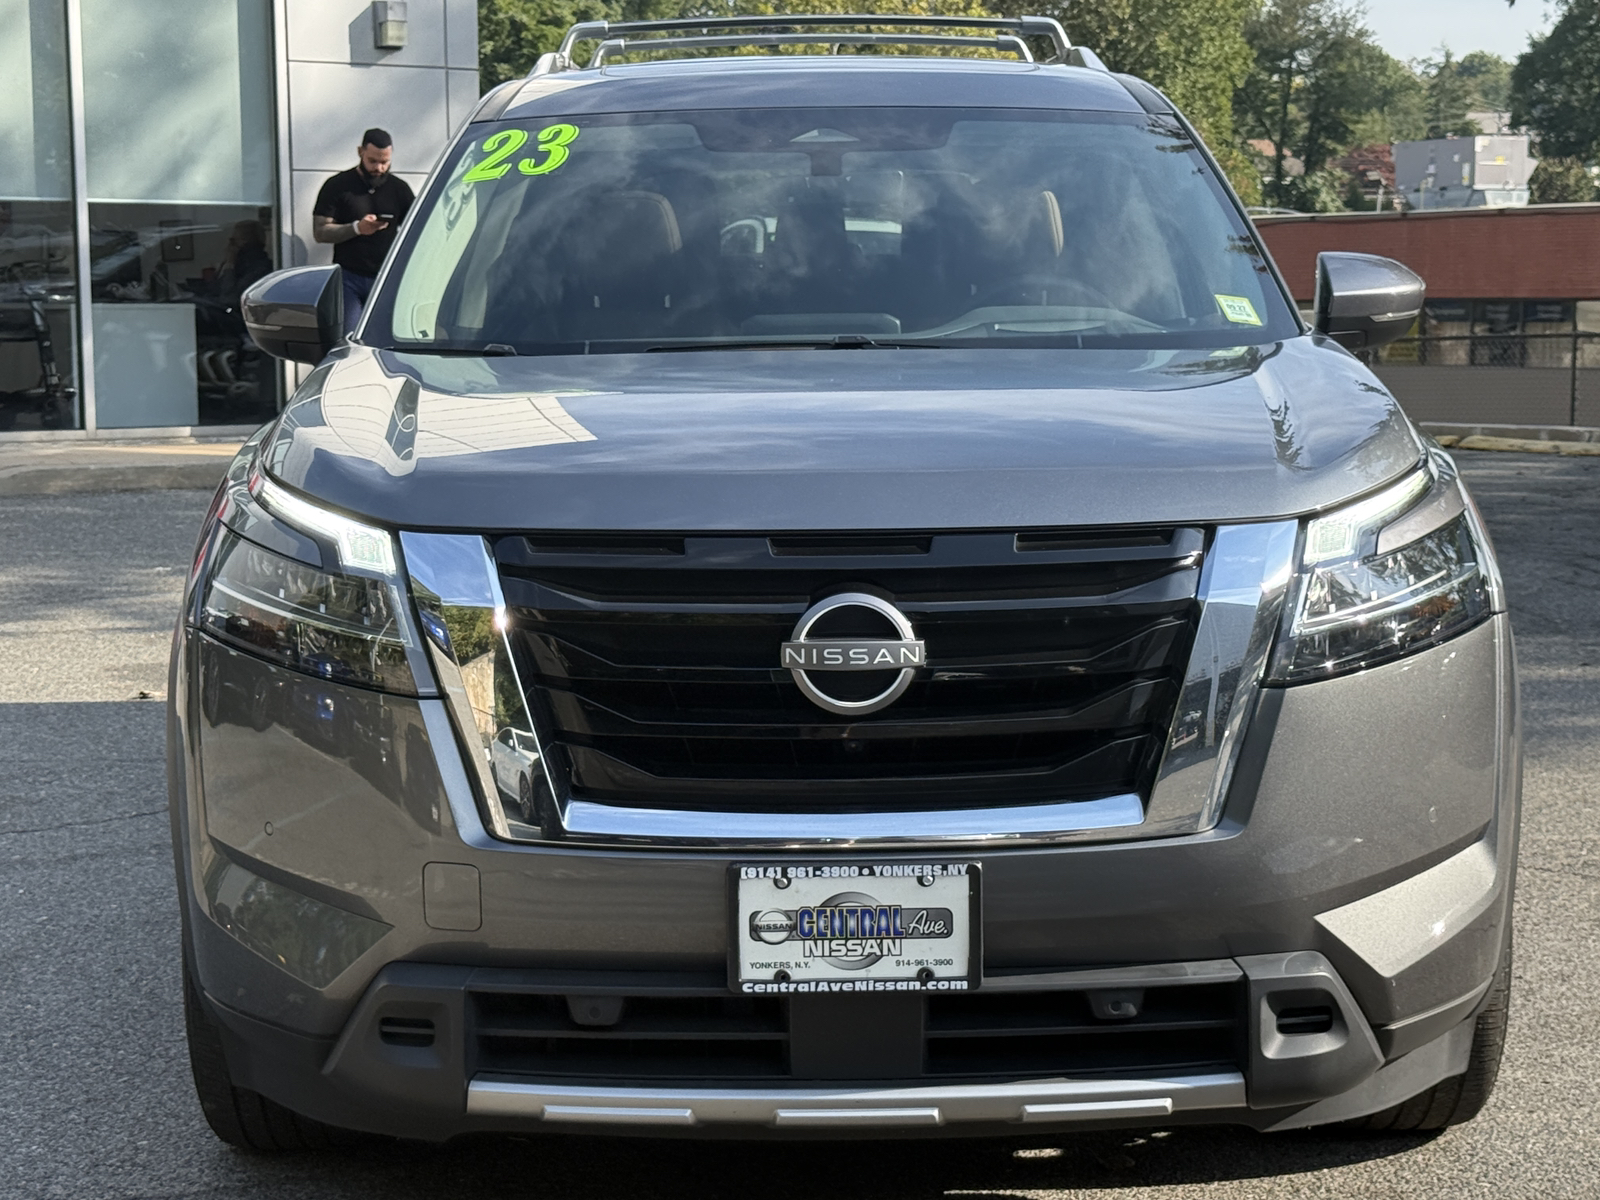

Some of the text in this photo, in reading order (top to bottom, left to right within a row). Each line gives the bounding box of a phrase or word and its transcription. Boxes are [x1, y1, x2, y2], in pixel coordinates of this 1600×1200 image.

[462, 124, 580, 184] 23
[785, 646, 920, 665] NISSAN
[787, 866, 859, 879] 961-3900
[755, 922, 792, 930] NISSAN
[797, 905, 949, 939] CENTRAL Ave.
[803, 938, 902, 958] NISSAN
[895, 959, 954, 967] 914-961-3900
[742, 980, 968, 993] CentralAveNissan.com
